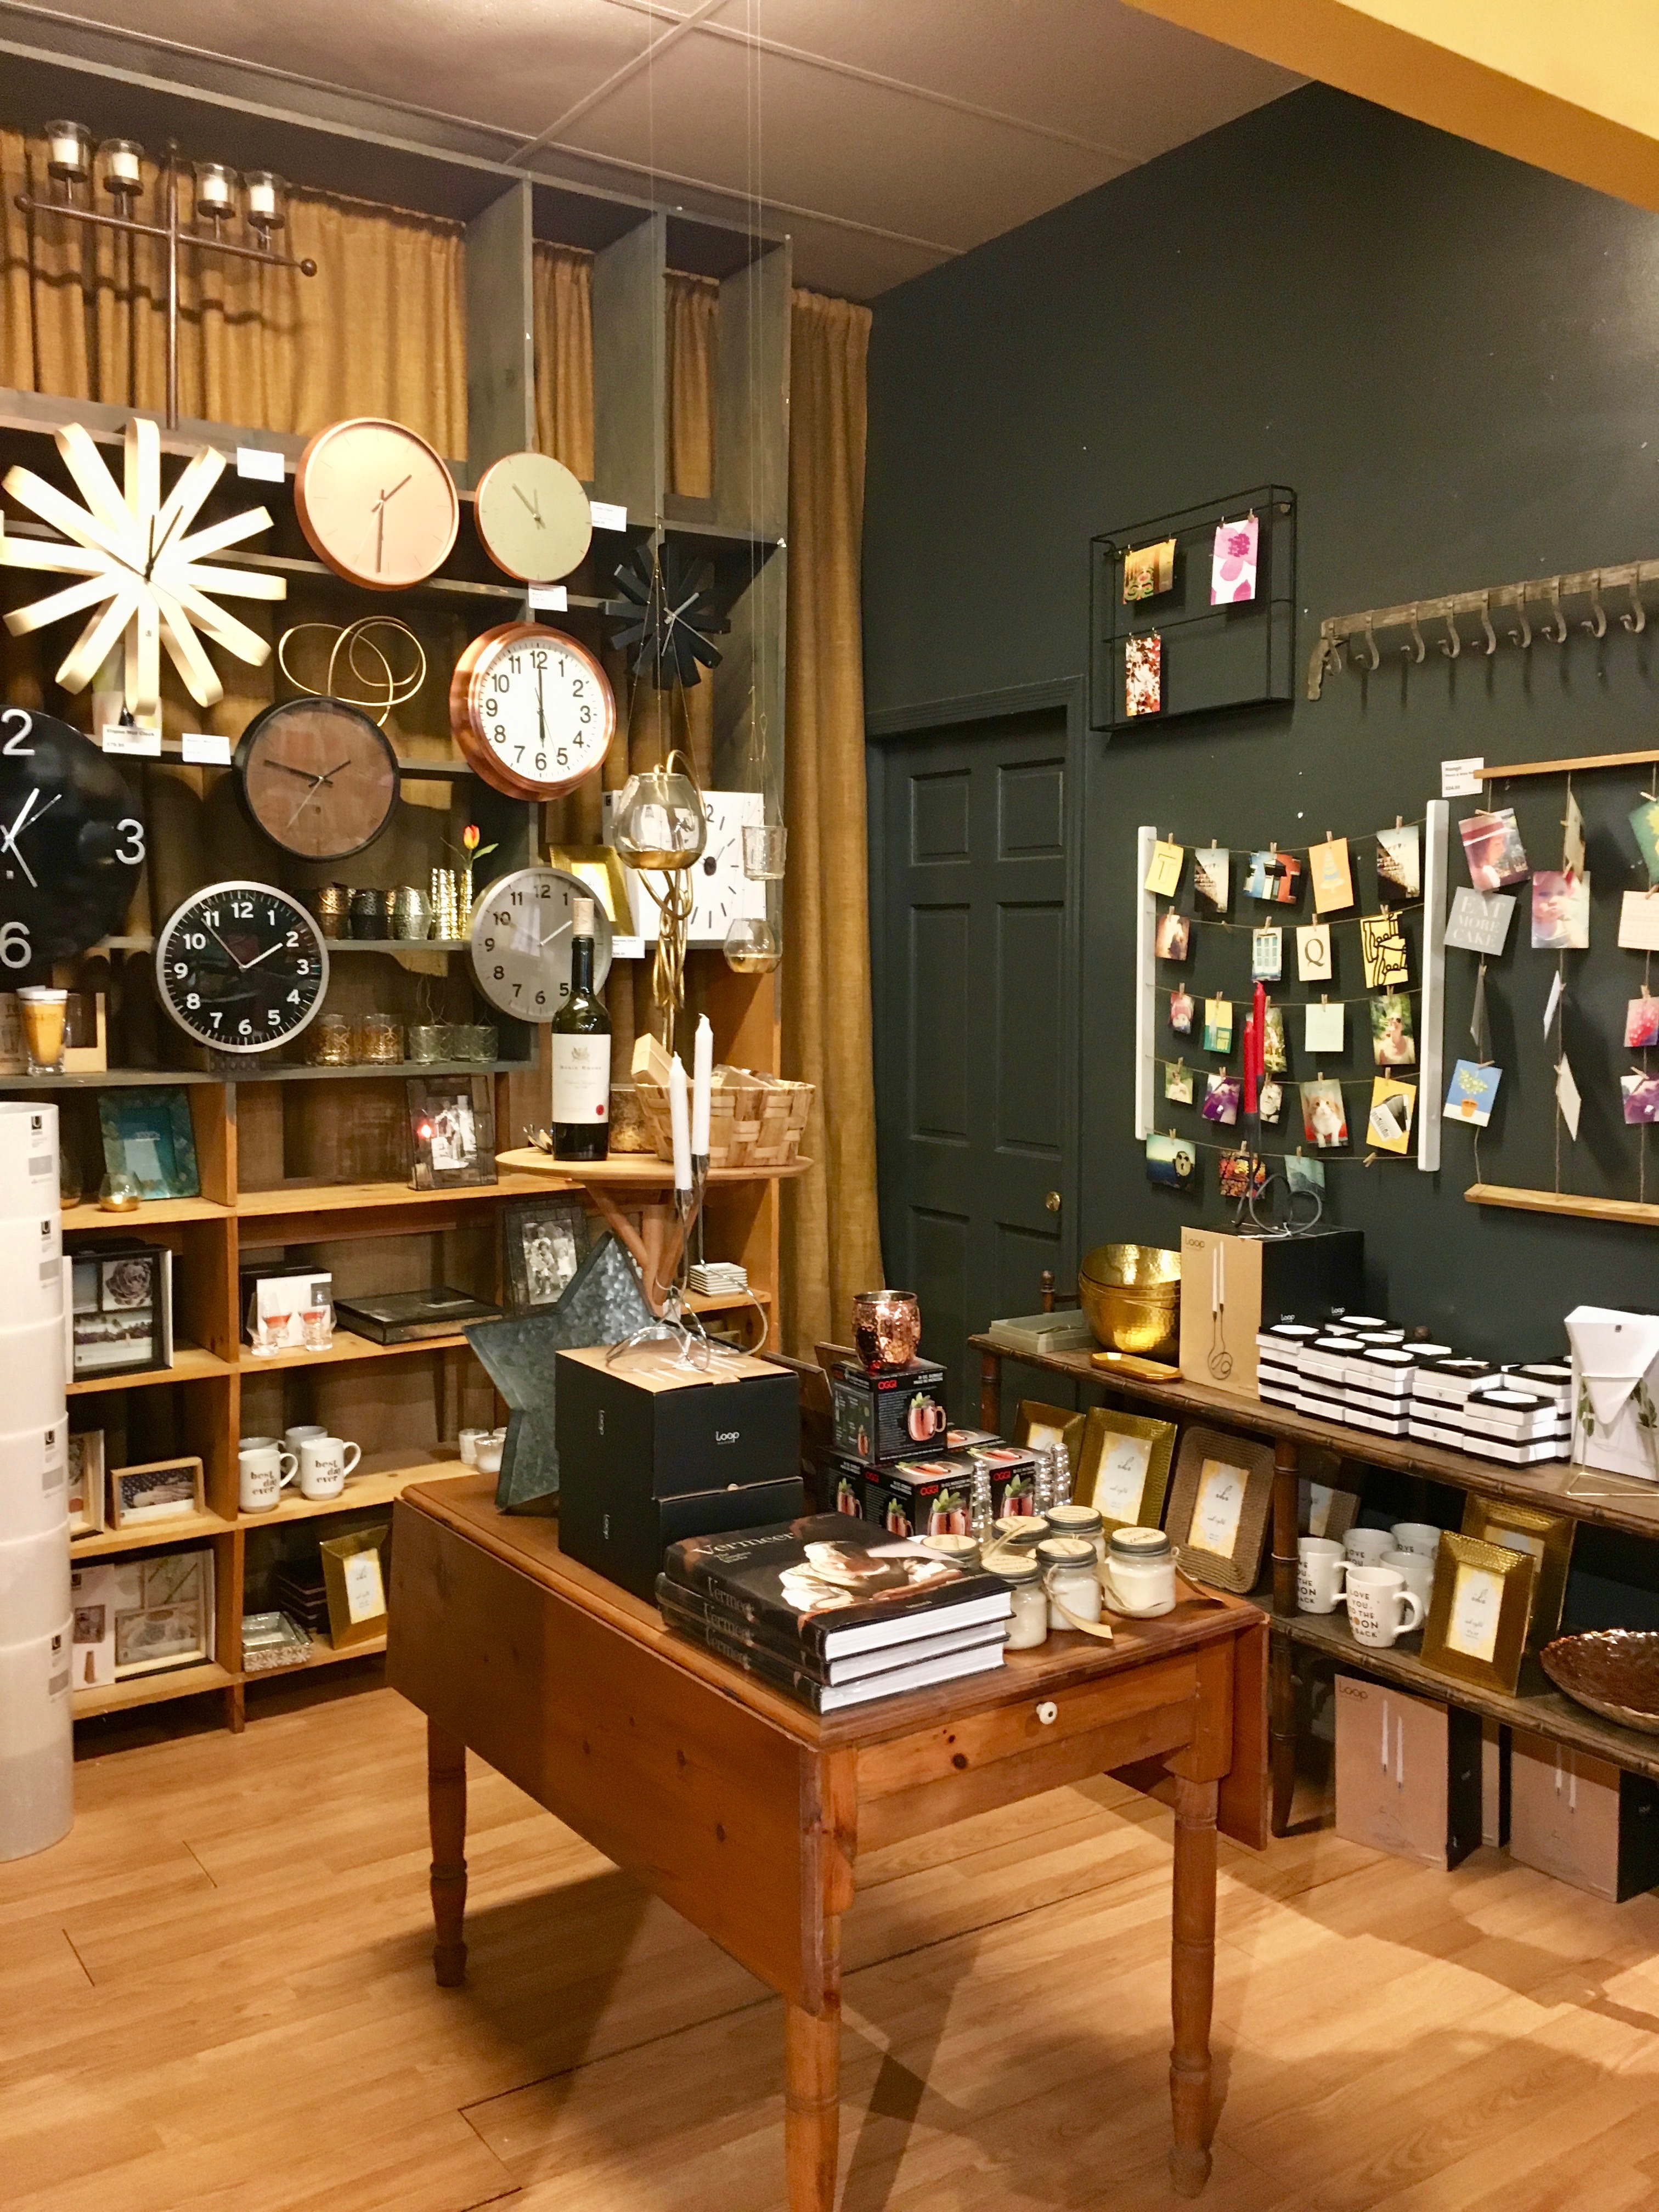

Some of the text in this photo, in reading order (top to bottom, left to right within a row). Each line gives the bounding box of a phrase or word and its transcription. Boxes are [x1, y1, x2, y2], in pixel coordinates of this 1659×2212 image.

[509, 656, 521, 674] 11
[530, 651, 547, 669] 12
[558, 660, 563, 677] 1
[493, 674, 509, 692] 10
[573, 680, 583, 697] 2
[486, 699, 498, 716] 9
[580, 706, 591, 723] 3
[2, 709, 35, 755] 2
[494, 725, 506, 743] 8
[573, 731, 584, 748] 4
[514, 746, 525, 763] 7
[535, 753, 546, 770] 6
[557, 748, 568, 765] 5
[706, 804, 715, 822] 2
[115, 819, 145, 864] 3
[1158, 853, 1178, 884] T
[511, 891, 522, 905] 11
[563, 893, 567, 905] 1
[231, 902, 253, 918] 12
[1461, 896, 1506, 918] EAT
[204, 911, 219, 927] 11
[268, 910, 274, 925] 1
[493, 912, 511, 925] 10
[1459, 914, 1501, 933] MORE
[0, 922, 31, 968] 6
[185, 933, 206, 949] 10
[286, 932, 298, 947] 2
[485, 938, 494, 952] 9
[1453, 929, 1497, 947] CAKE
[1305, 938, 1324, 967] Q
[174, 963, 188, 979] 9
[297, 959, 309, 974] 3
[494, 966, 504, 980] 8
[287, 989, 300, 1004] 4
[512, 984, 521, 997] 7
[535, 991, 545, 1004] 6
[560, 983, 569, 996] 5
[187, 993, 200, 1009] 8
[210, 1012, 222, 1028] 7
[268, 1010, 280, 1025] 5
[239, 1019, 252, 1035] 6
[1185, 1234, 1205, 1251] Loop
[715, 1431, 740, 1443] Loop
[690, 1532, 794, 1555] Vermeer
[1397, 1544, 1414, 1553] OVE
[1301, 1587, 1316, 1596] ON
[1352, 1599, 1368, 1609] YOU
[1358, 1610, 1375, 1619] THE
[1339, 1681, 1368, 1702] Loop
